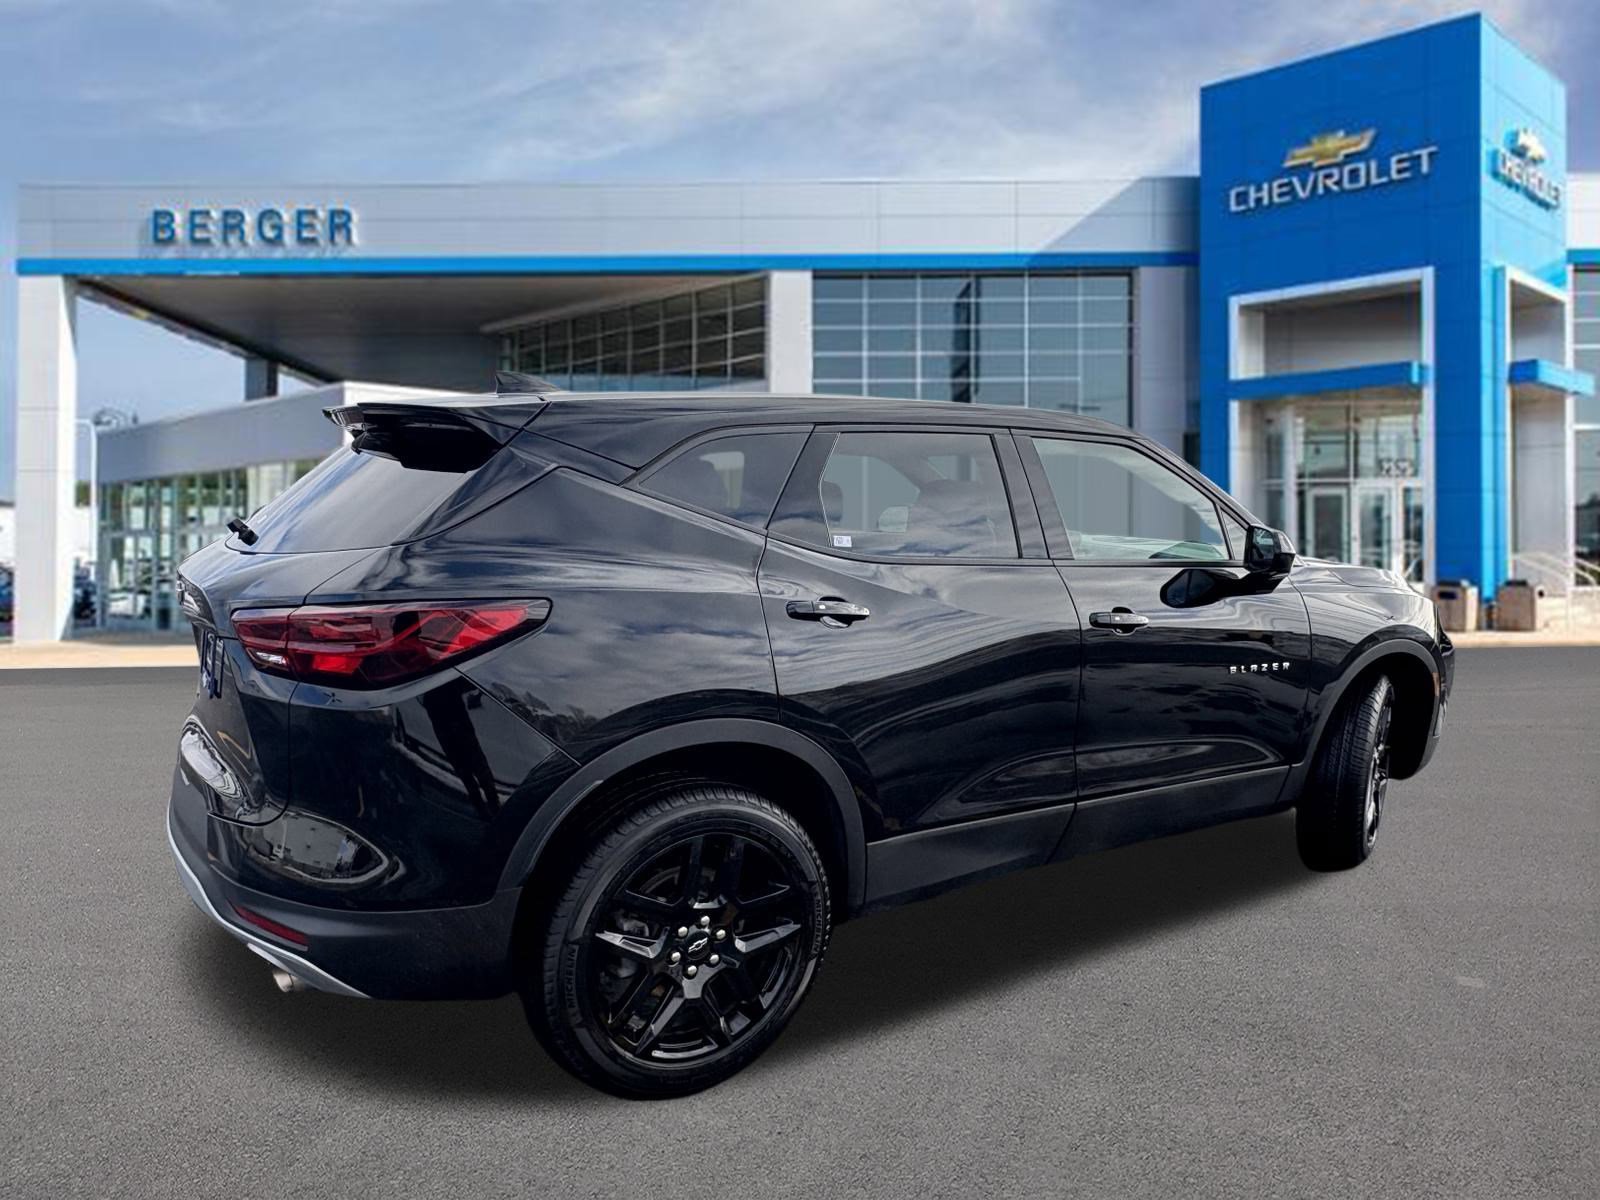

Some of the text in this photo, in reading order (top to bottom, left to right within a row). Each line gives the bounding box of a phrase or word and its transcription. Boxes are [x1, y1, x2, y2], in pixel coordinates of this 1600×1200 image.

[1228, 146, 1437, 213] CHEVROLET
[152, 207, 355, 246] BERGER
[1229, 661, 1290, 674] BLAZER
[566, 947, 578, 1009] MICHELIN
